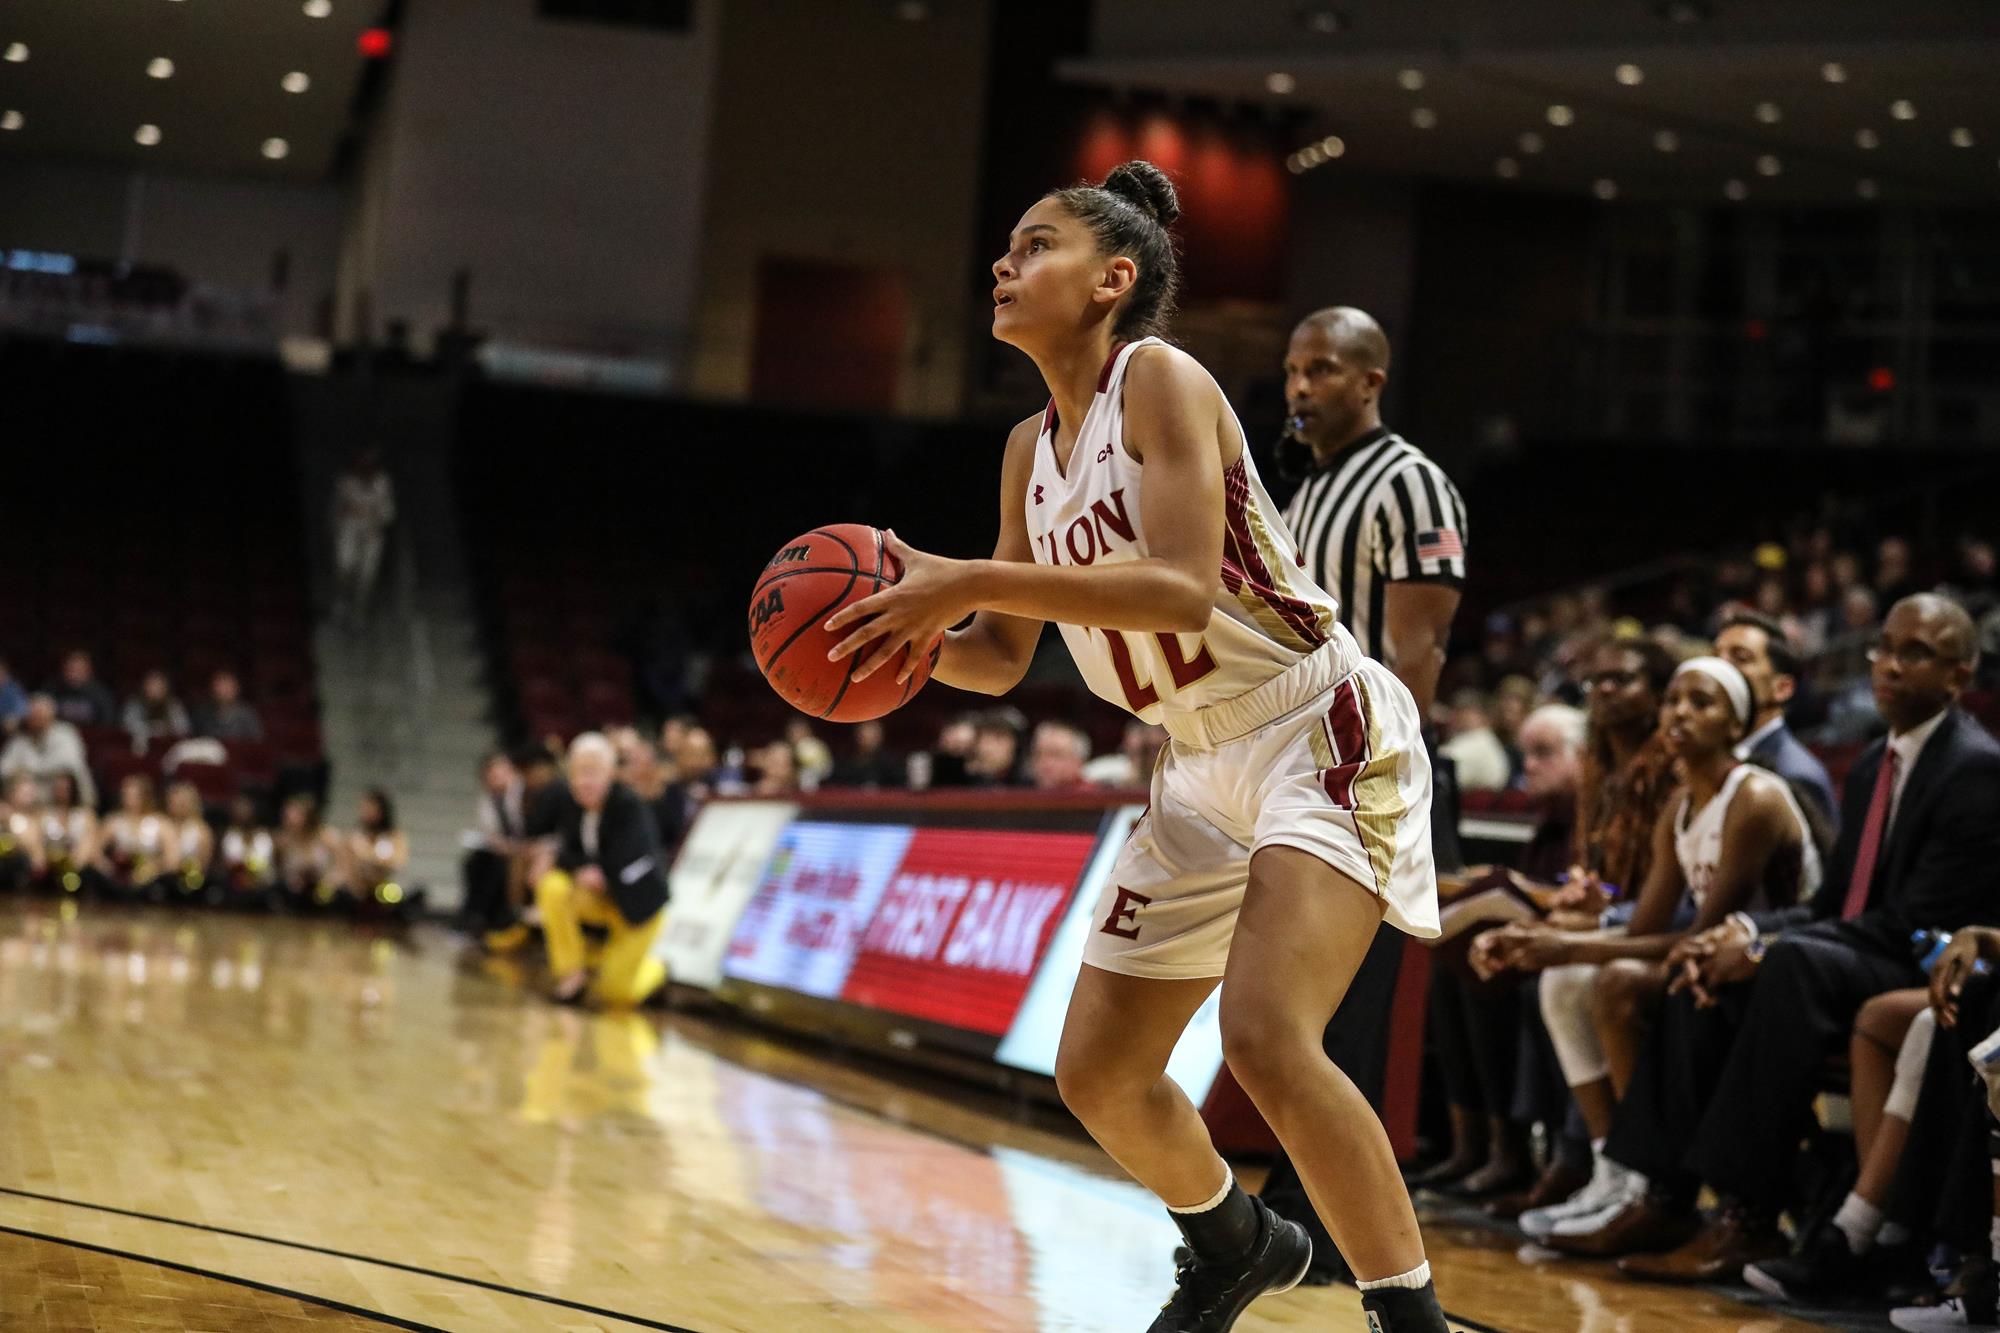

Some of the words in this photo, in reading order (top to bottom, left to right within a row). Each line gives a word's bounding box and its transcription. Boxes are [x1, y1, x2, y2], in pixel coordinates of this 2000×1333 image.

[1037, 488, 1138, 566] LON
[864, 872, 972, 960] FIRST
[942, 878, 1066, 976] BANK
[1099, 885, 1152, 941] E
